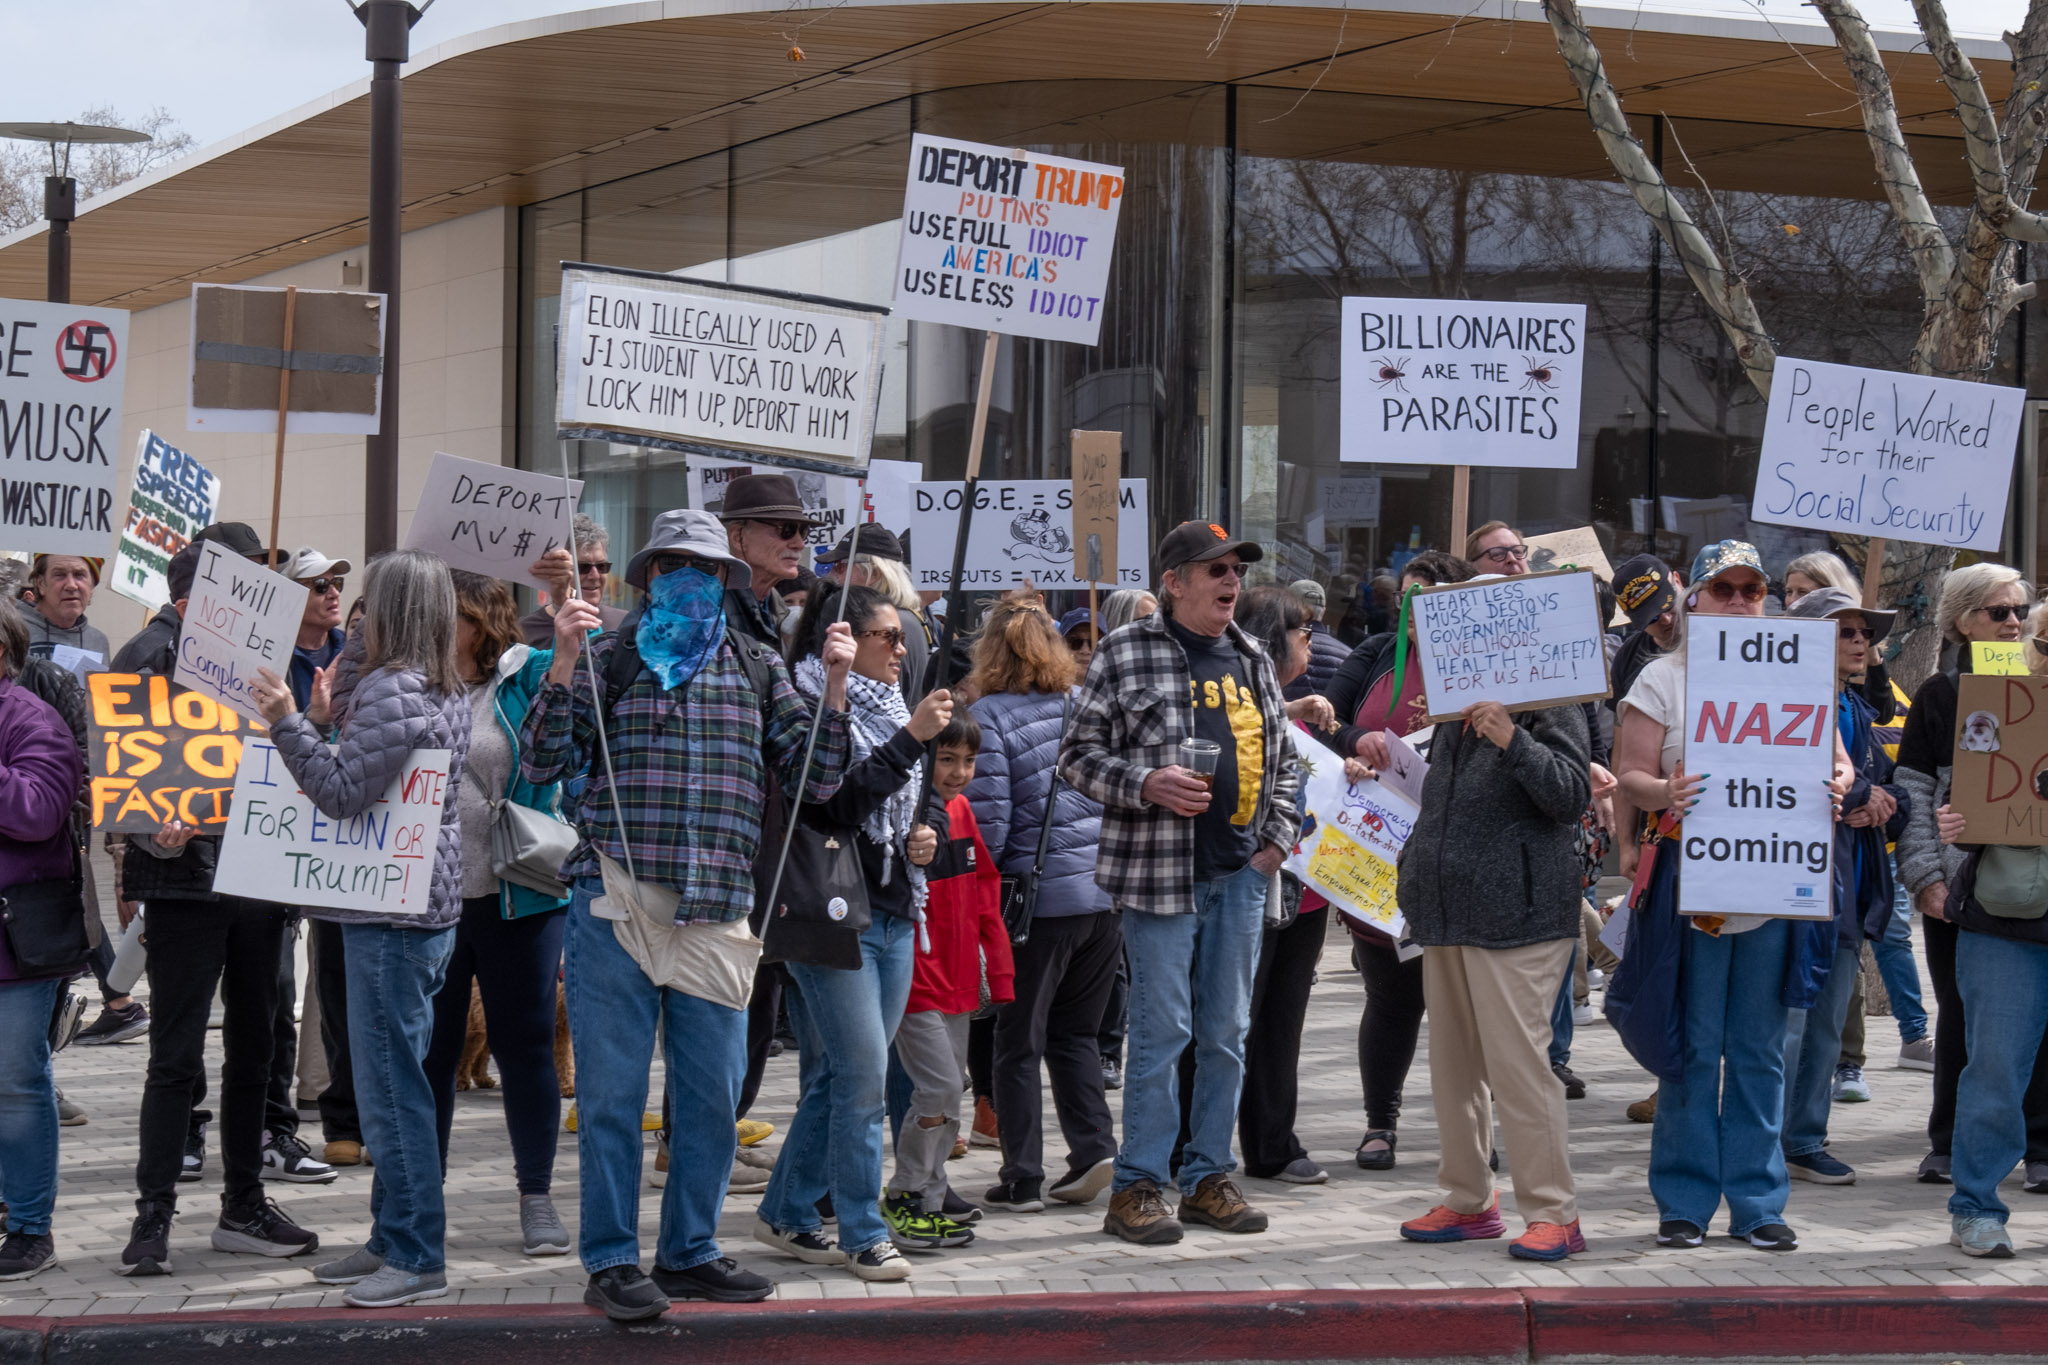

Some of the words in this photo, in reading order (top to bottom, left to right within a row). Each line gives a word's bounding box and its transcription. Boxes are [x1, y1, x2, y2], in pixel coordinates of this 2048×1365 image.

[918, 146, 1028, 197] DEPORT
[1034, 164, 1125, 210] TRUMP
[909, 210, 1011, 250] USEFULL
[1028, 228, 1088, 260] IDIOT
[942, 244, 1058, 283] AMERICA'S
[904, 268, 1014, 308] USELESS
[1029, 289, 1101, 321] IDIOT
[588, 295, 640, 330] ELON
[650, 303, 761, 346] ILLEGALLY
[768, 318, 817, 353] USED
[824, 328, 845, 358] A
[1361, 312, 1575, 354] BILLIONAIRES
[582, 335, 613, 368] J-1
[620, 340, 699, 379] STUDENT
[709, 351, 762, 388] VISA
[770, 360, 793, 392] TO
[801, 363, 858, 401] WORK
[1421, 363, 1459, 380] ARE
[1470, 363, 1509, 382] THE
[587, 375, 642, 413] LOCK
[649, 384, 687, 418] HIM
[699, 391, 726, 428] UP,
[733, 396, 800, 433] DEPORT
[807, 405, 849, 440] HIM
[1382, 395, 1559, 440] PARASITES
[1787, 368, 1875, 441] People
[1893, 382, 1995, 448] Worked
[0, 400, 112, 466] MUSK
[1820, 431, 1864, 465] for
[1876, 439, 1935, 472] their
[144, 432, 214, 504] FREE
[136, 464, 212, 526] SPEECH
[451, 474, 577, 519] DEPORT
[916, 488, 1023, 511] D.O.G.E.
[1033, 494, 1044, 506] =
[1056, 487, 1136, 510] SM
[1765, 462, 1866, 523] Social
[1871, 477, 1985, 543] Security
[201, 549, 222, 585] I
[231, 575, 276, 616] will
[920, 570, 952, 583] IRS
[1012, 571, 1023, 582] =
[1030, 569, 1066, 583] TAX
[200, 595, 244, 636] NOT
[1425, 608, 1476, 629] MUSK
[1487, 593, 1560, 619] DESTOYS
[1436, 649, 1517, 676] HEALTH
[1524, 651, 1536, 664] +
[1541, 636, 1597, 663] SAFETY
[1719, 630, 1726, 661] I
[1741, 632, 1799, 664] did
[1984, 647, 2021, 665] Depo
[1444, 672, 1485, 693] FOR
[1495, 669, 1519, 685] US
[1694, 700, 1828, 747] NAZI
[104, 731, 168, 777] is
[249, 744, 278, 787] I
[400, 766, 446, 805] VOTE
[90, 776, 235, 828] FASCI
[1346, 783, 1412, 839] Democracy
[1725, 777, 1797, 809] this
[244, 800, 297, 841] FOR
[311, 806, 390, 850] ELON
[394, 823, 425, 854] OR
[1361, 810, 1384, 832] NO
[1685, 832, 1828, 874] coming
